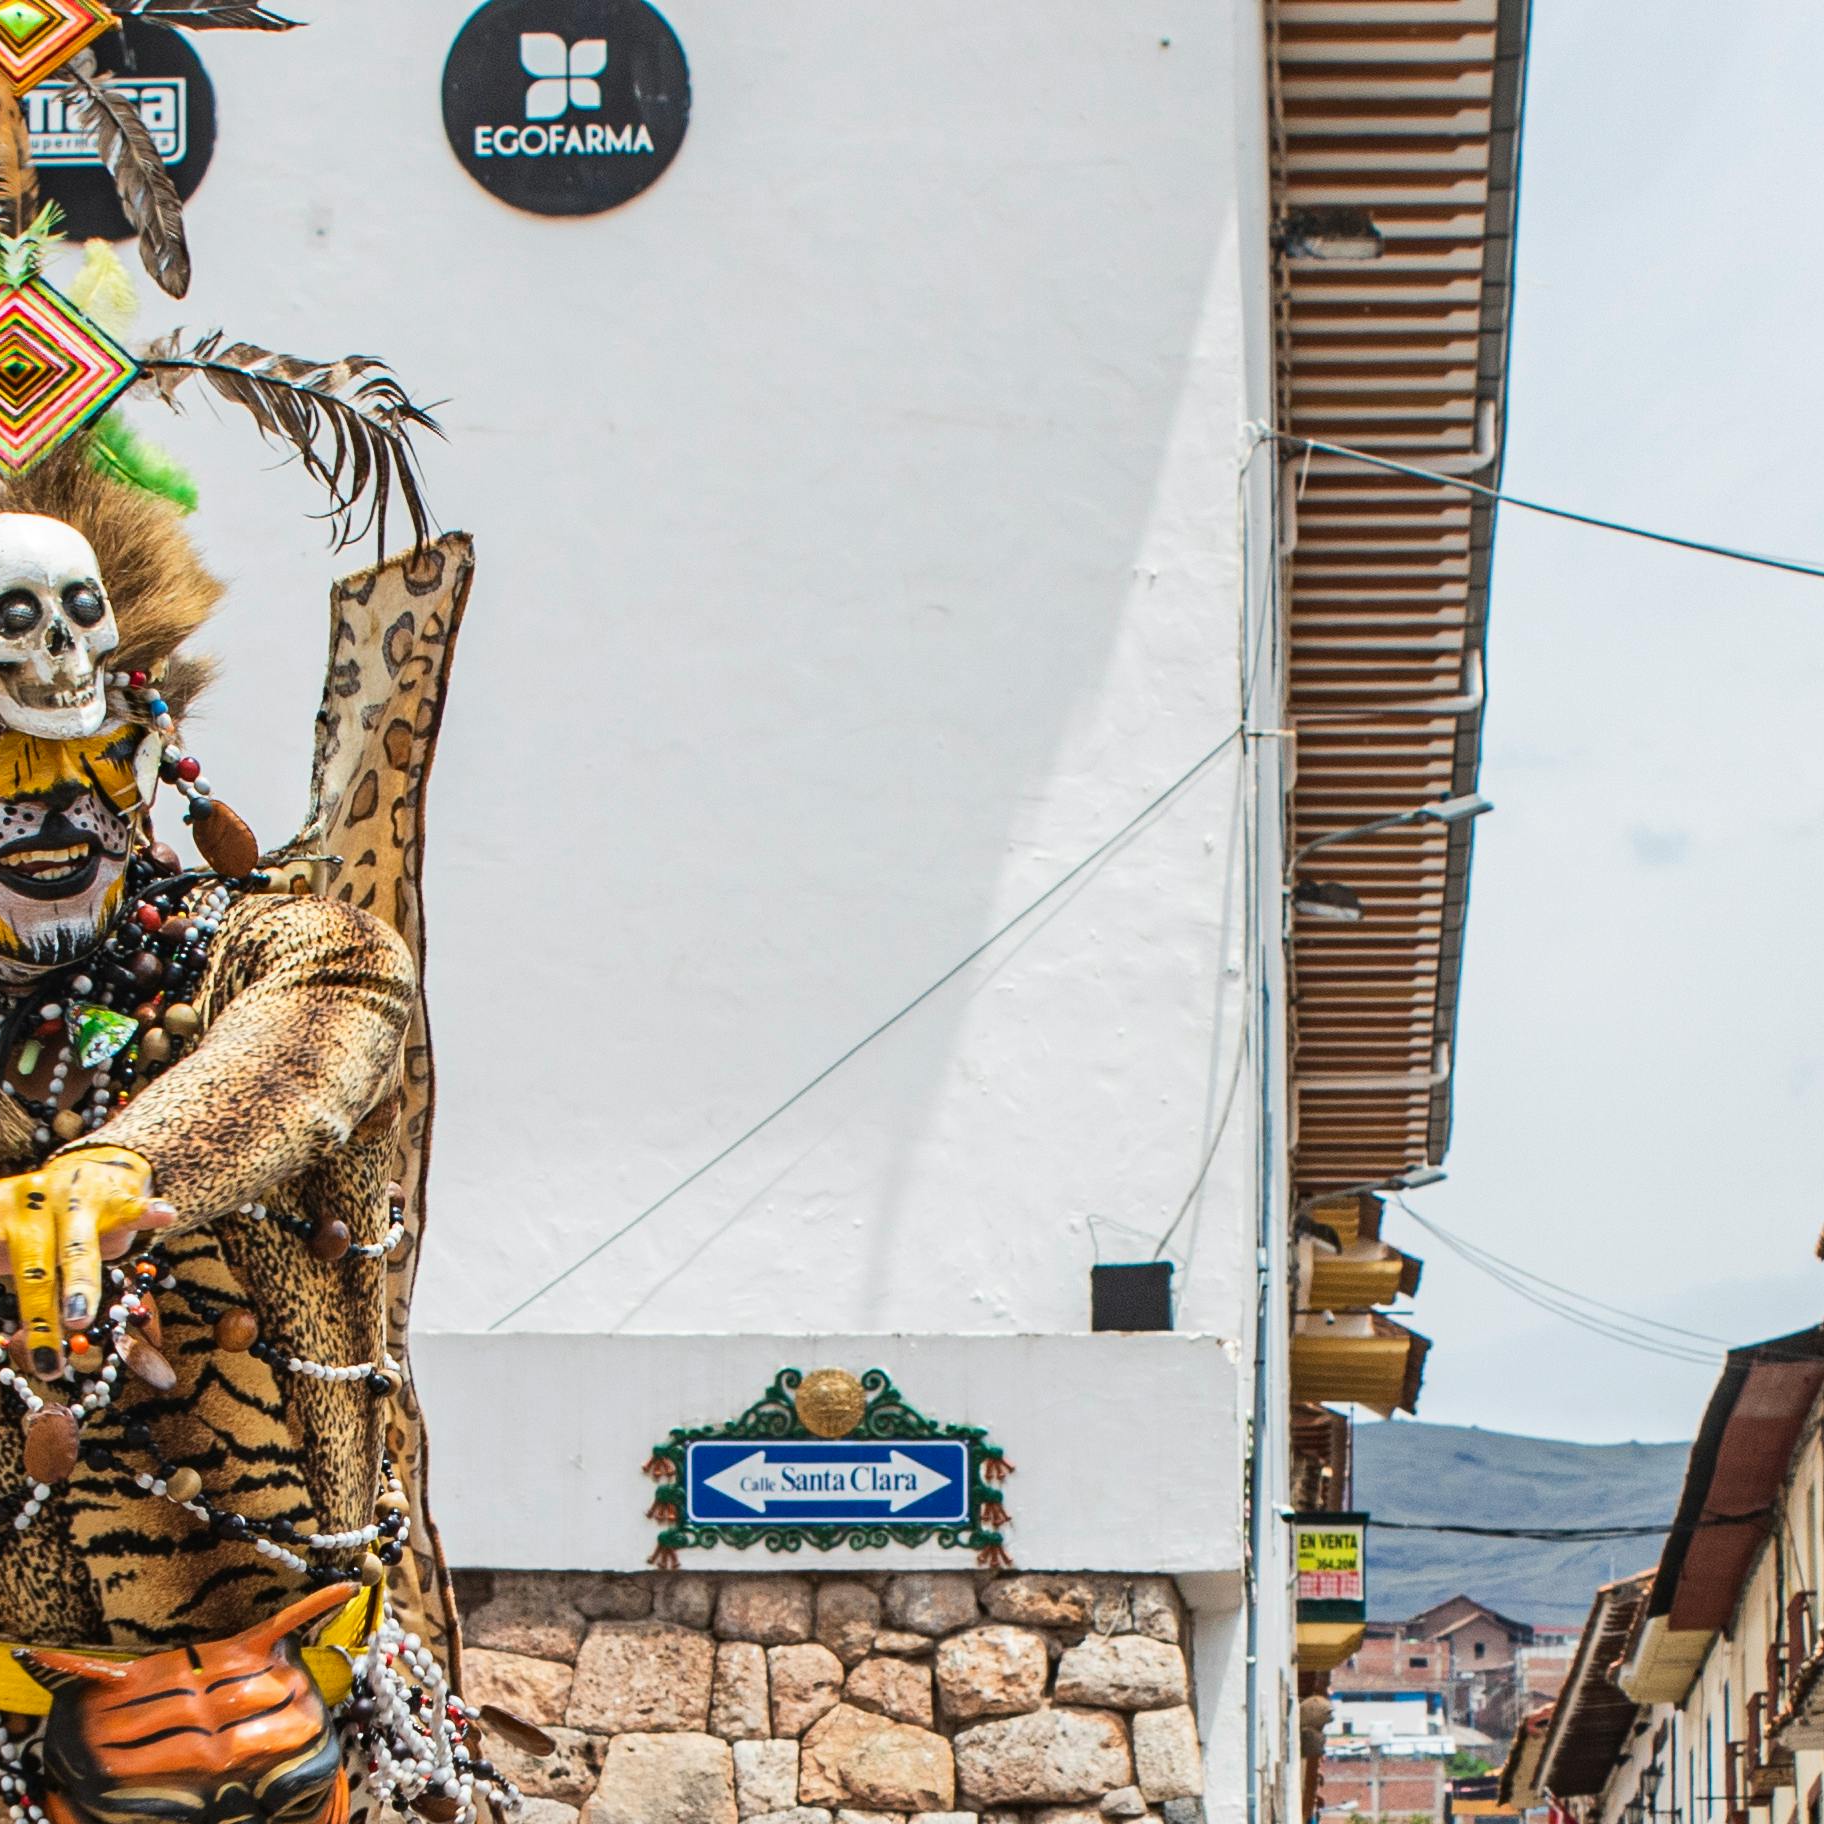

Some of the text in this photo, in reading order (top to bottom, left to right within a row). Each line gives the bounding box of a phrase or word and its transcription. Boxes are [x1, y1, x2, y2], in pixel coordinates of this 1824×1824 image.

[474, 124, 655, 157] EGOFARMA
[740, 1465, 918, 1492] Calle Santa Clara
[1300, 1533, 1358, 1549] EN VENTA
